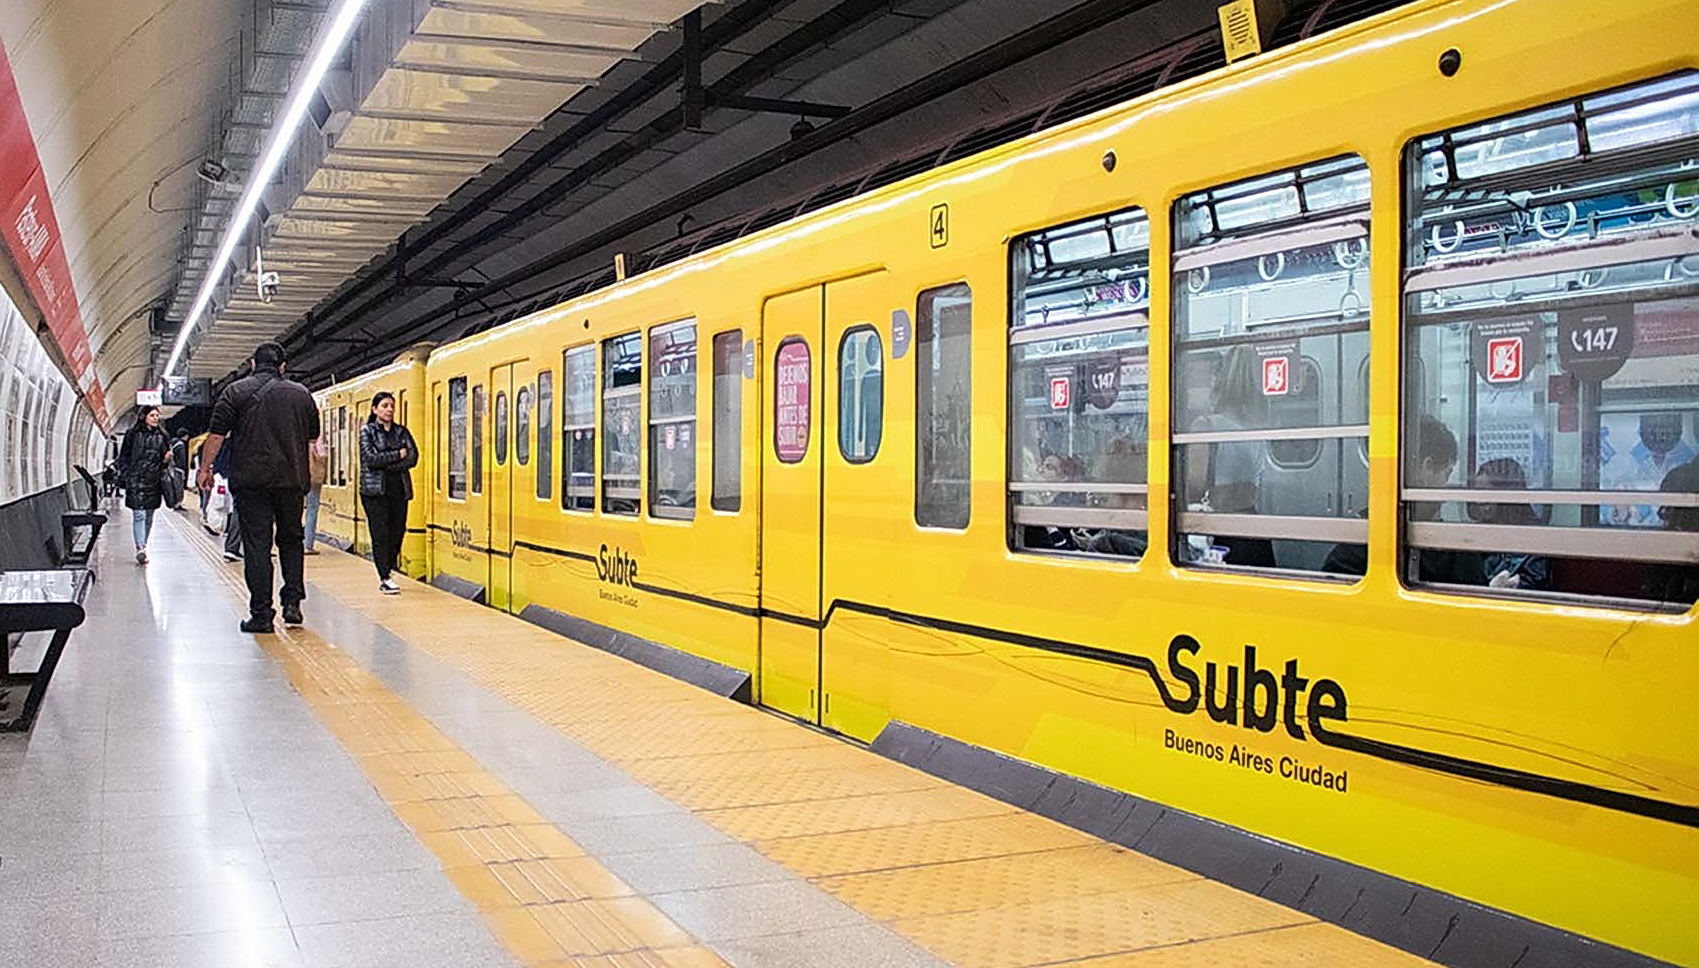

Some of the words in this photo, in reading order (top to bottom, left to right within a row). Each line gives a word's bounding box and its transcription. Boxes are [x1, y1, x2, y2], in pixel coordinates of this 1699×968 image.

[933, 210, 945, 240] 4
[1583, 327, 1618, 352] 147
[1097, 372, 1115, 389] 147
[598, 543, 638, 588] Subte
[1163, 634, 1348, 745] Subte
[1164, 728, 1224, 762] Buenos
[1229, 744, 1274, 774] Aires
[1279, 756, 1348, 793] Ciudad
